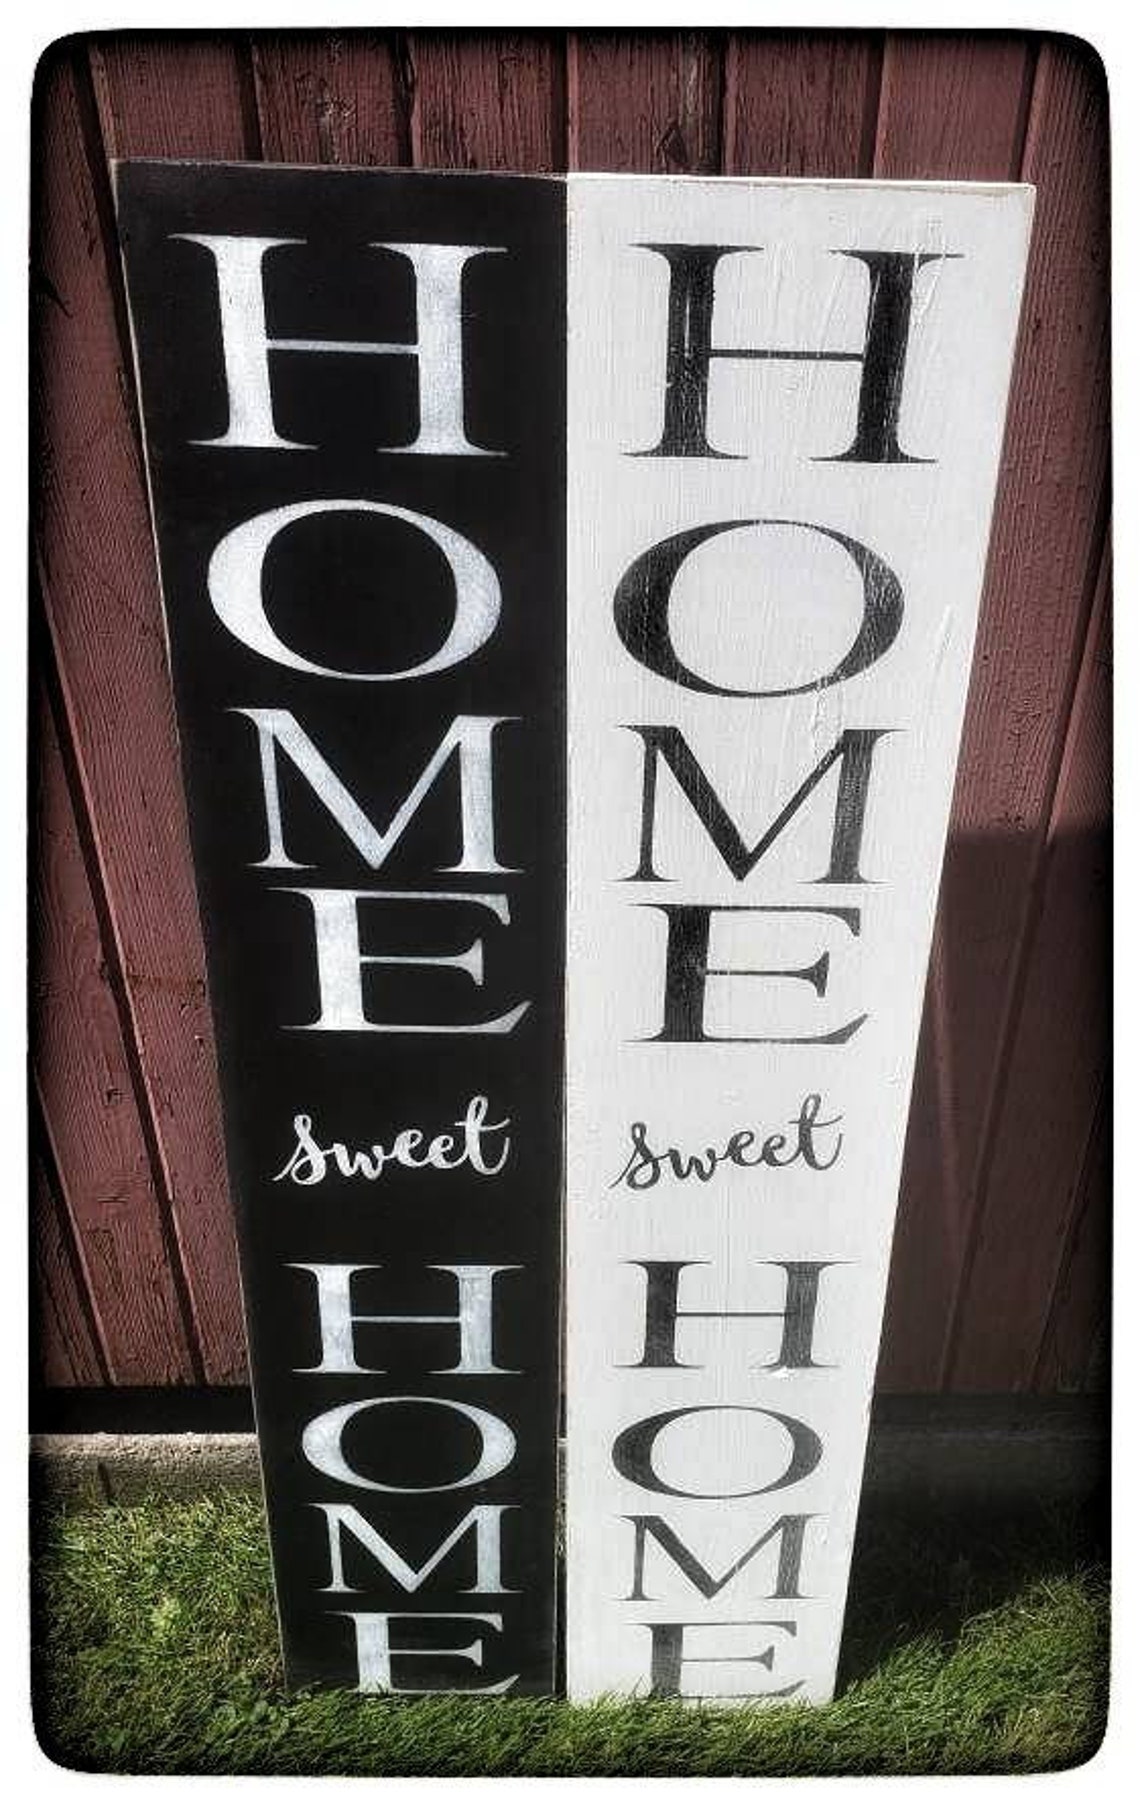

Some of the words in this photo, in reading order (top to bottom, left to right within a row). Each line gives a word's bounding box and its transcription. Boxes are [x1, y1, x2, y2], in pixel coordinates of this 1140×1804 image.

[167, 234, 531, 1032] HOME
[610, 243, 966, 1045] HOME
[273, 1096, 512, 1185] sweet
[612, 1095, 845, 1188] sweet
[281, 1261, 525, 1696] HOME
[611, 1260, 855, 1699] HOME
